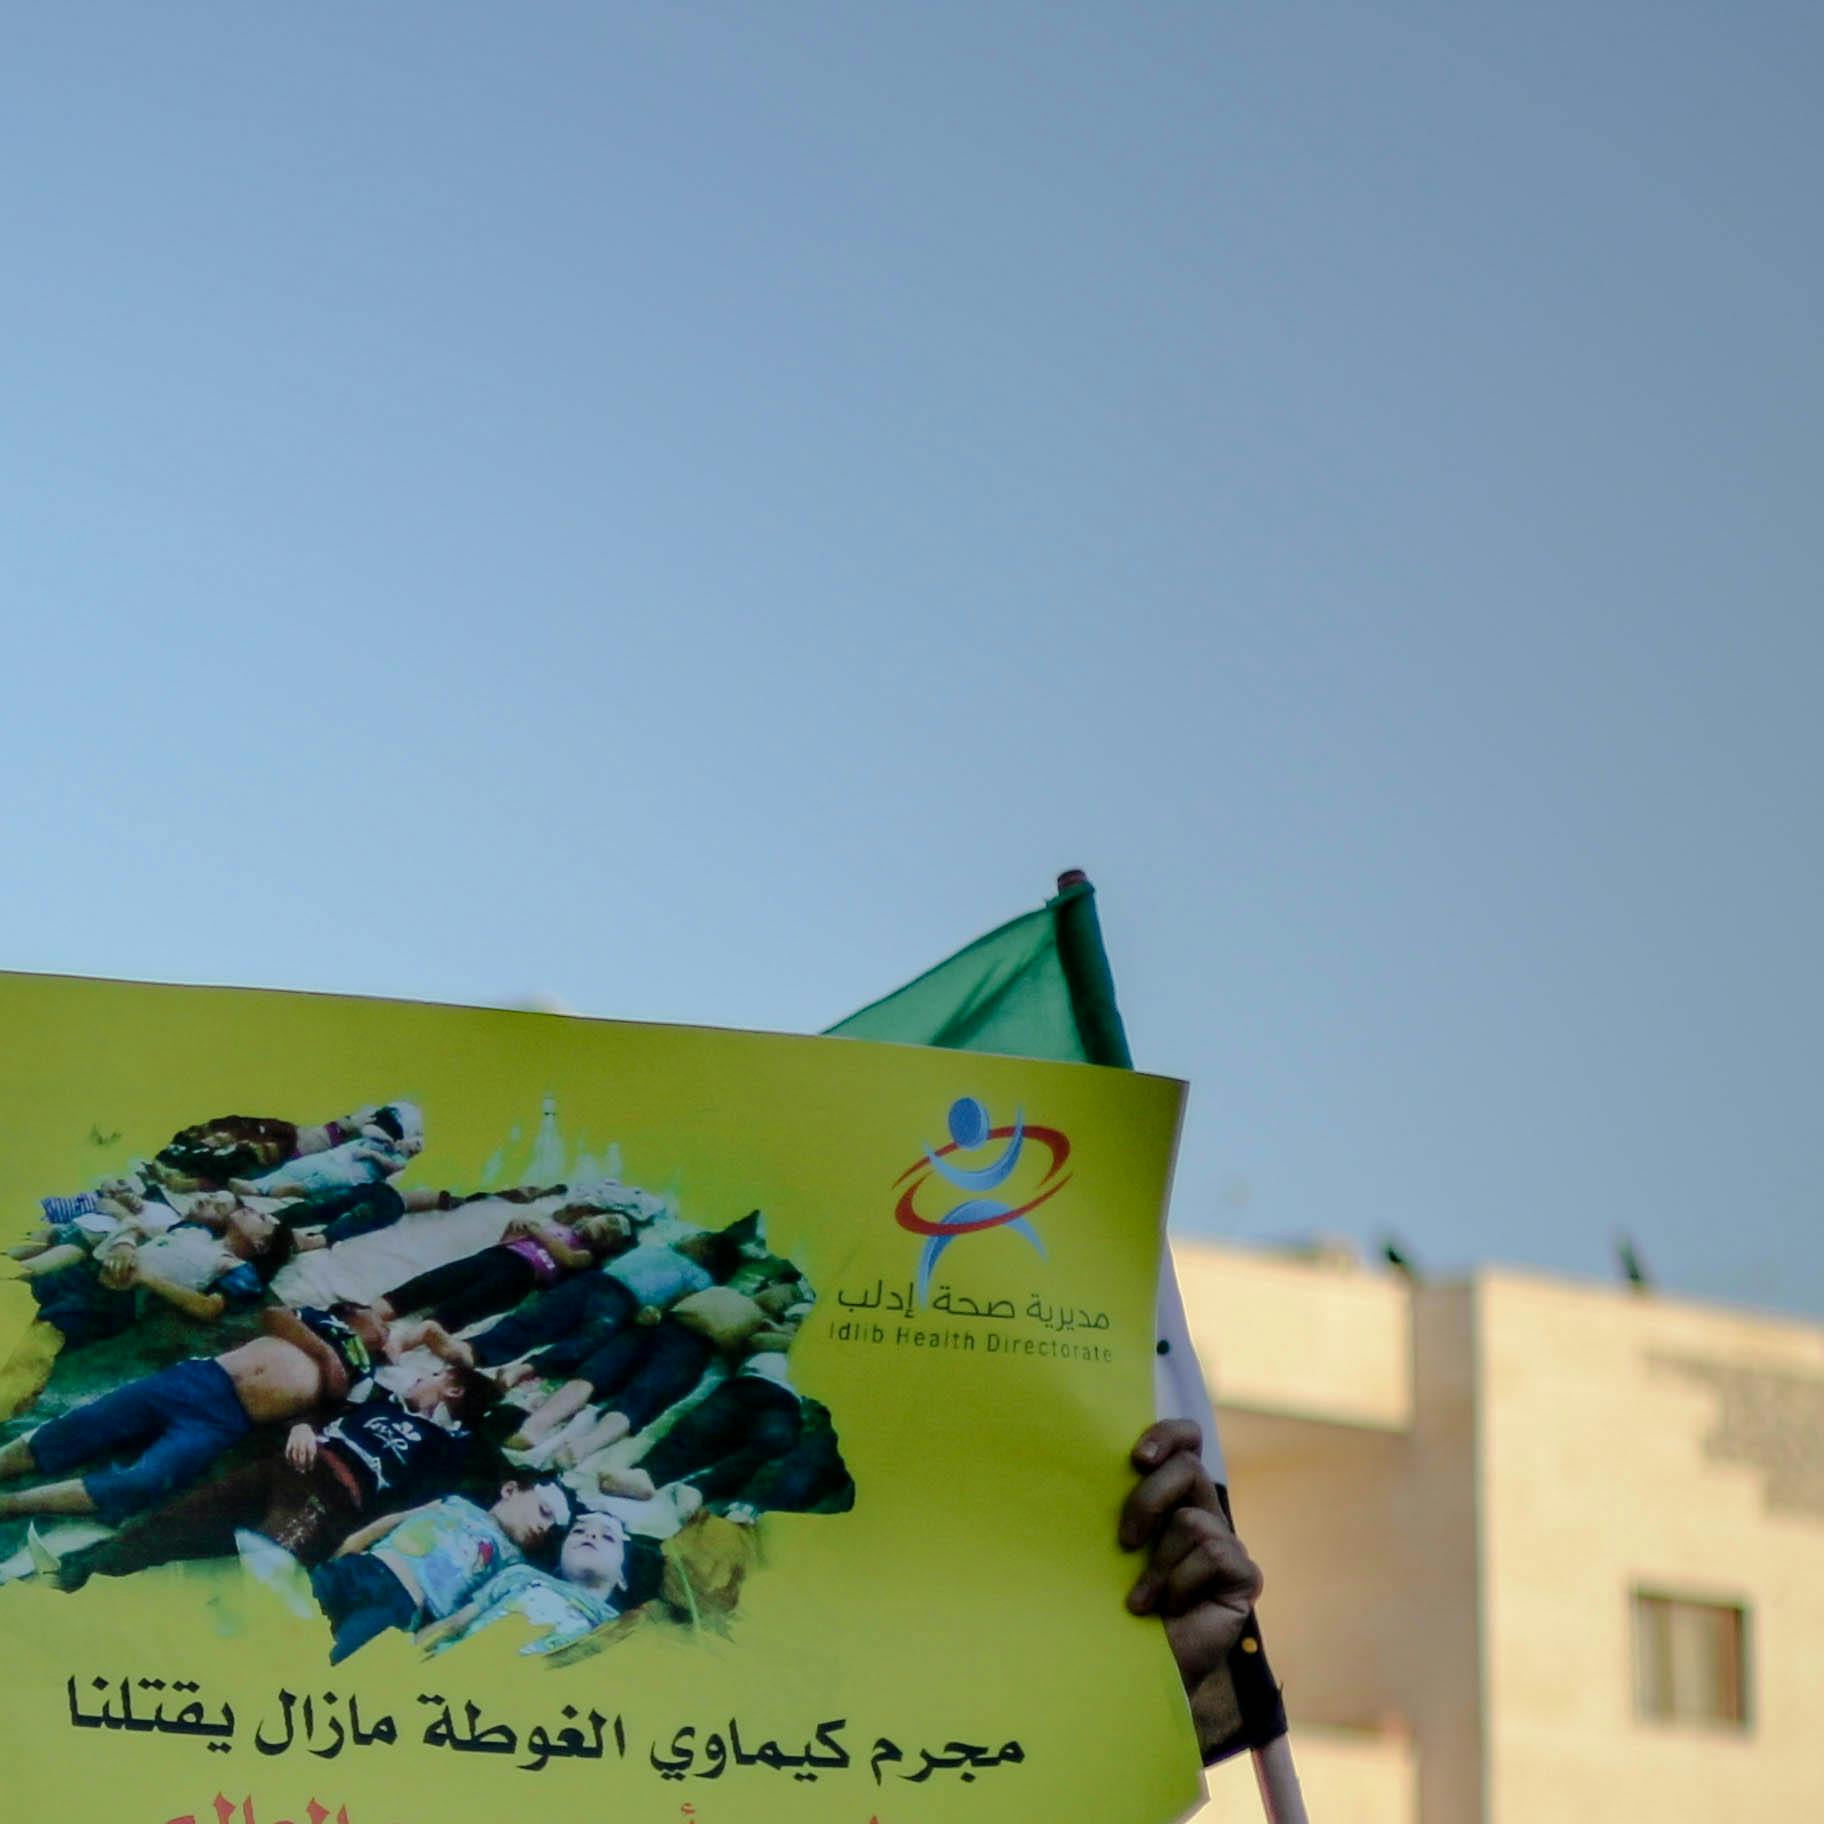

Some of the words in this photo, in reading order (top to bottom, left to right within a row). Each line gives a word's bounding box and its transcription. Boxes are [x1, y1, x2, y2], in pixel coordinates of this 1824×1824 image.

[837, 1279, 914, 1318] إدلب
[932, 1285, 1016, 1319] صحة
[1025, 1293, 1110, 1331] مديرية
[829, 1321, 884, 1343] Idlib
[896, 1327, 975, 1352] Health
[987, 1333, 1112, 1363] Directorate
[66, 1673, 236, 1755] يقتلنا
[253, 1687, 399, 1760] مازال
[417, 1693, 627, 1773] الغوطة
[649, 1716, 852, 1784] كيماوي
[869, 1736, 1026, 1787] مجرم
